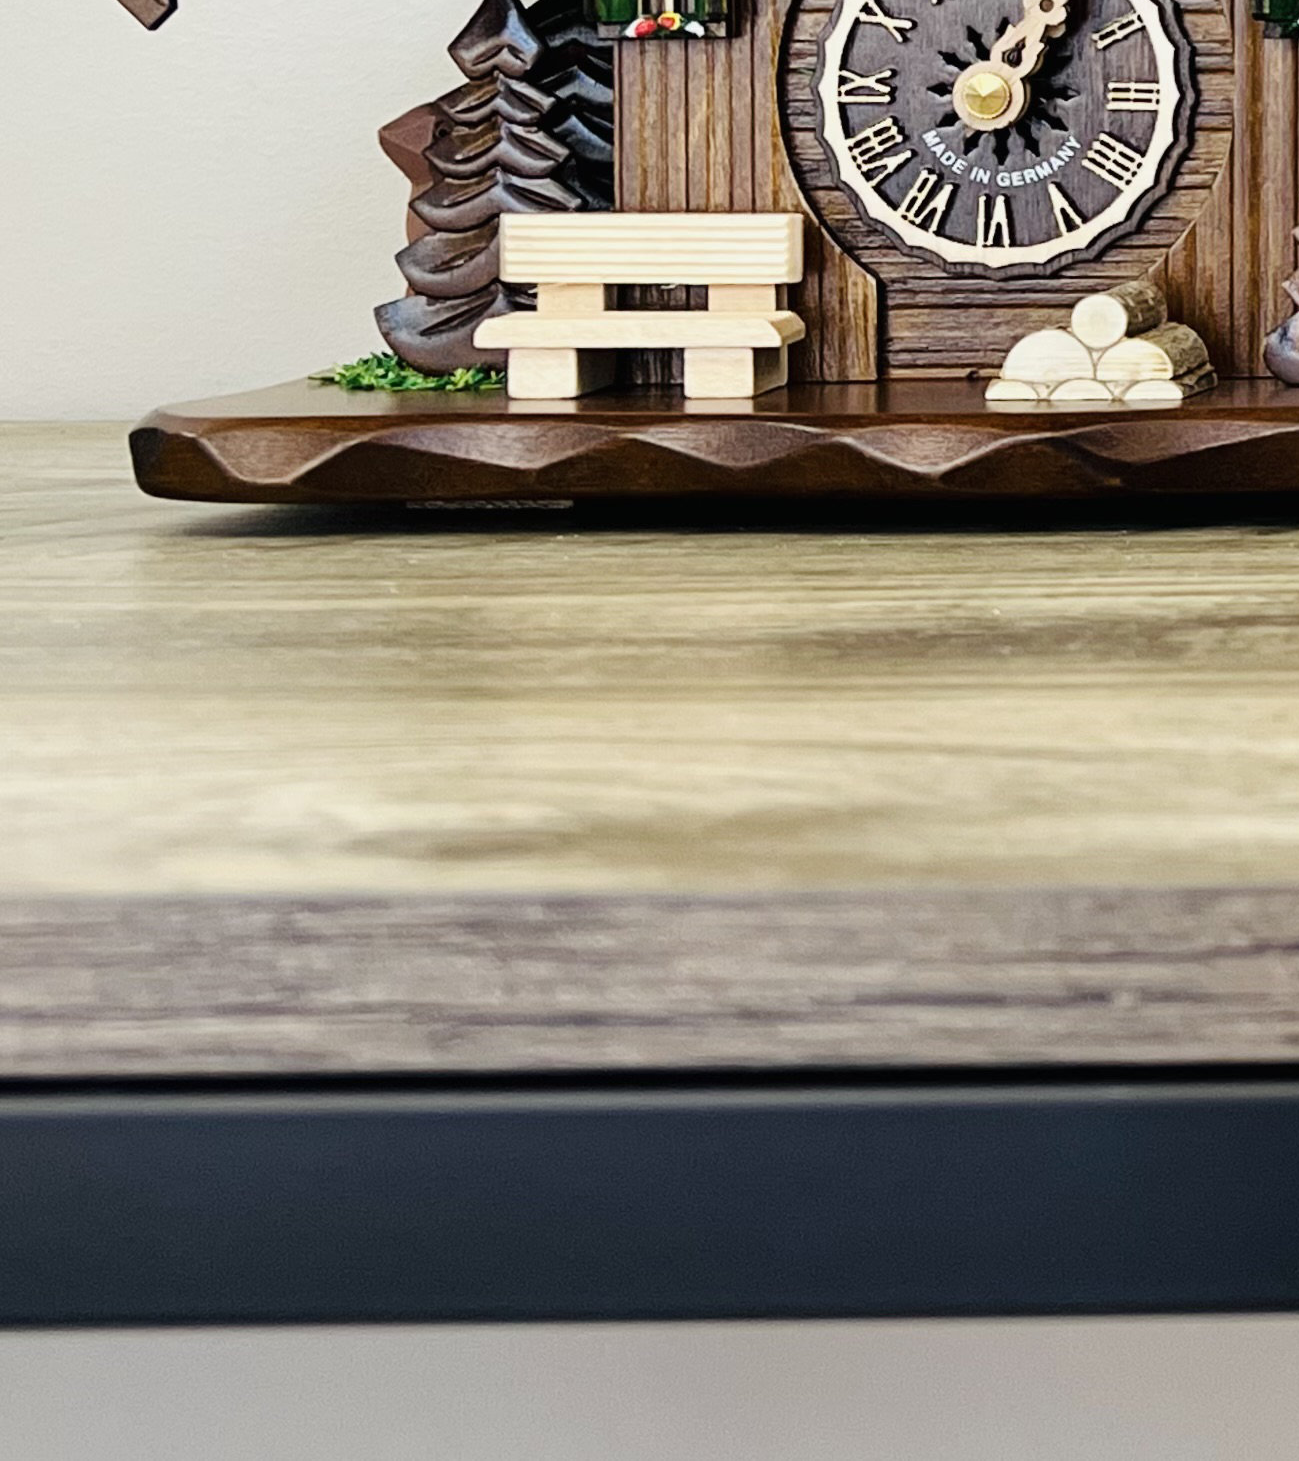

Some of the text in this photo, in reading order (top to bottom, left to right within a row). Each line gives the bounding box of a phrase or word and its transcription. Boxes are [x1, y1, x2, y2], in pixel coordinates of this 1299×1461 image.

[858, 0, 917, 42] X
[838, 69, 895, 104] IX
[1107, 82, 1160, 110] III
[922, 129, 1082, 188] MADE IN GERMANY
